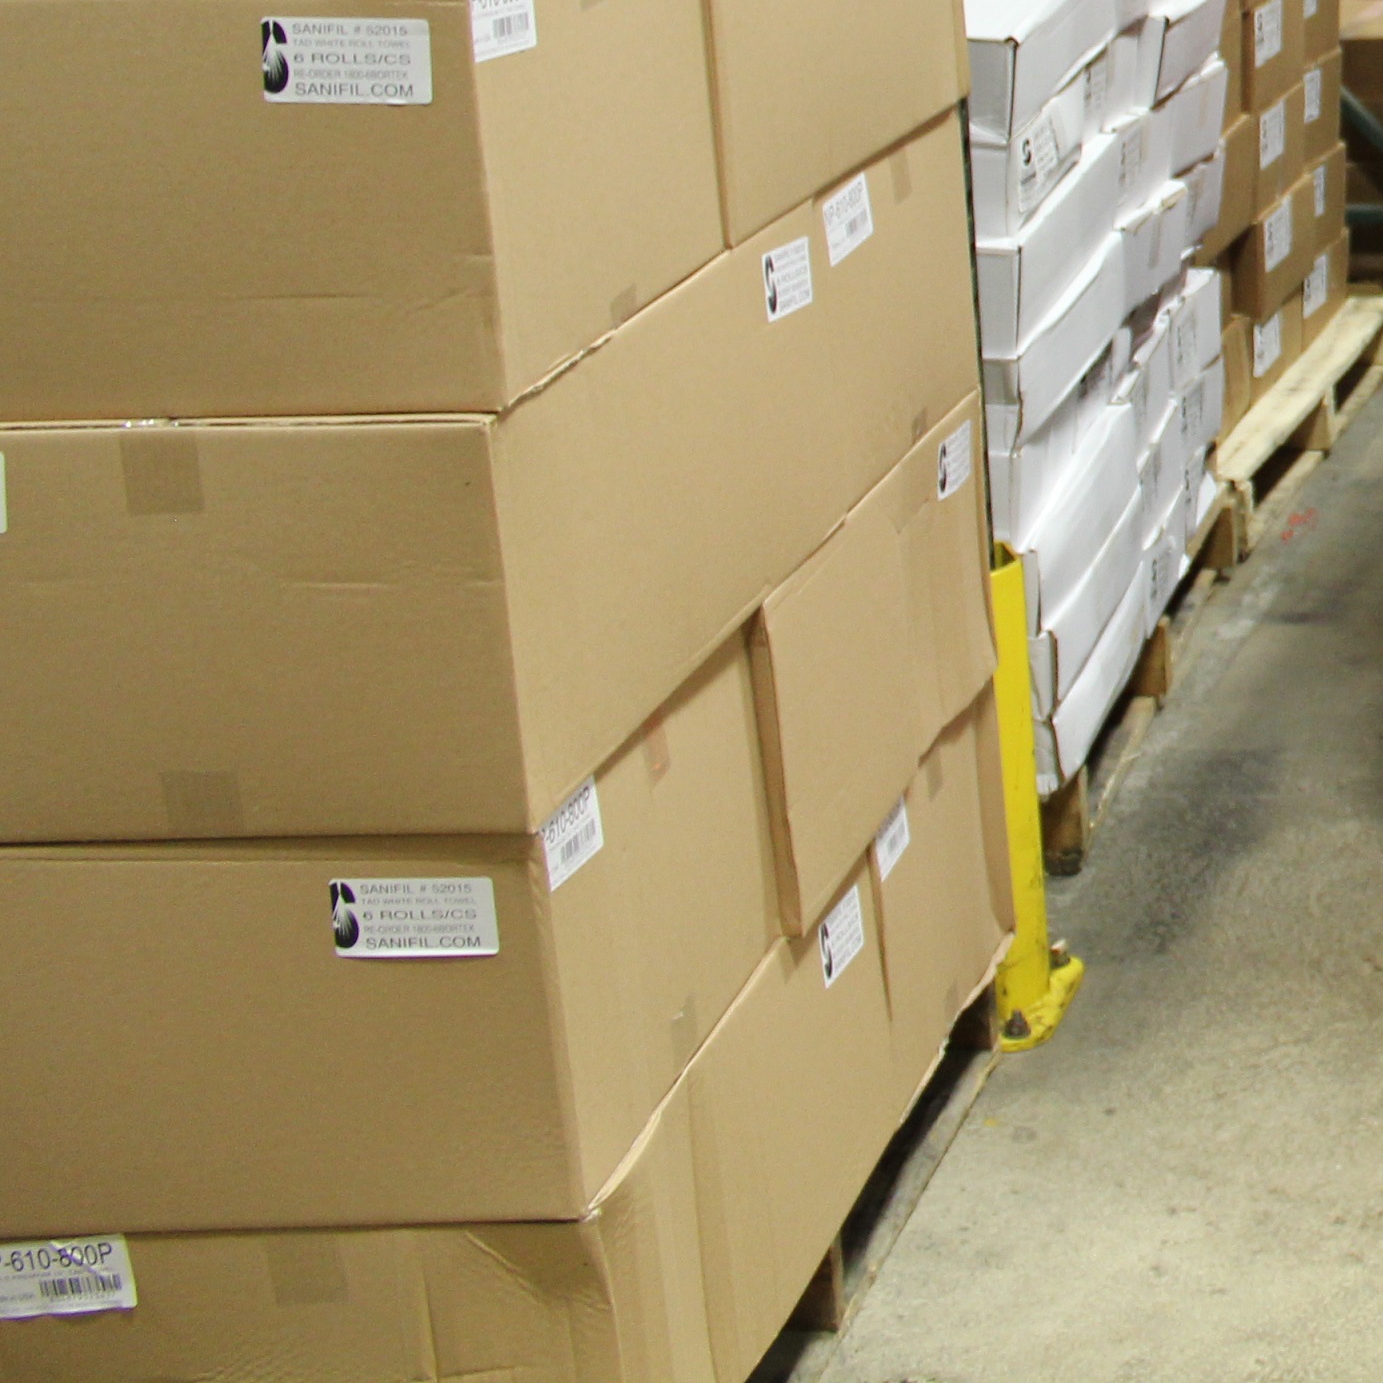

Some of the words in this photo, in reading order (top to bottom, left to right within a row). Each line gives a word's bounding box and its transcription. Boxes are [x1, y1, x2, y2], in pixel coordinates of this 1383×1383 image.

[292, 24, 349, 36] SANIFIL
[293, 53, 304, 64] 6
[311, 53, 411, 65] ROLLS/CS
[295, 83, 414, 97] SANIFIL.COM
[360, 884, 414, 894] SANIFIL
[363, 911, 373, 921] 6
[380, 909, 477, 920] ROLLS/CS
[366, 936, 481, 950] SANIFIL.COM
